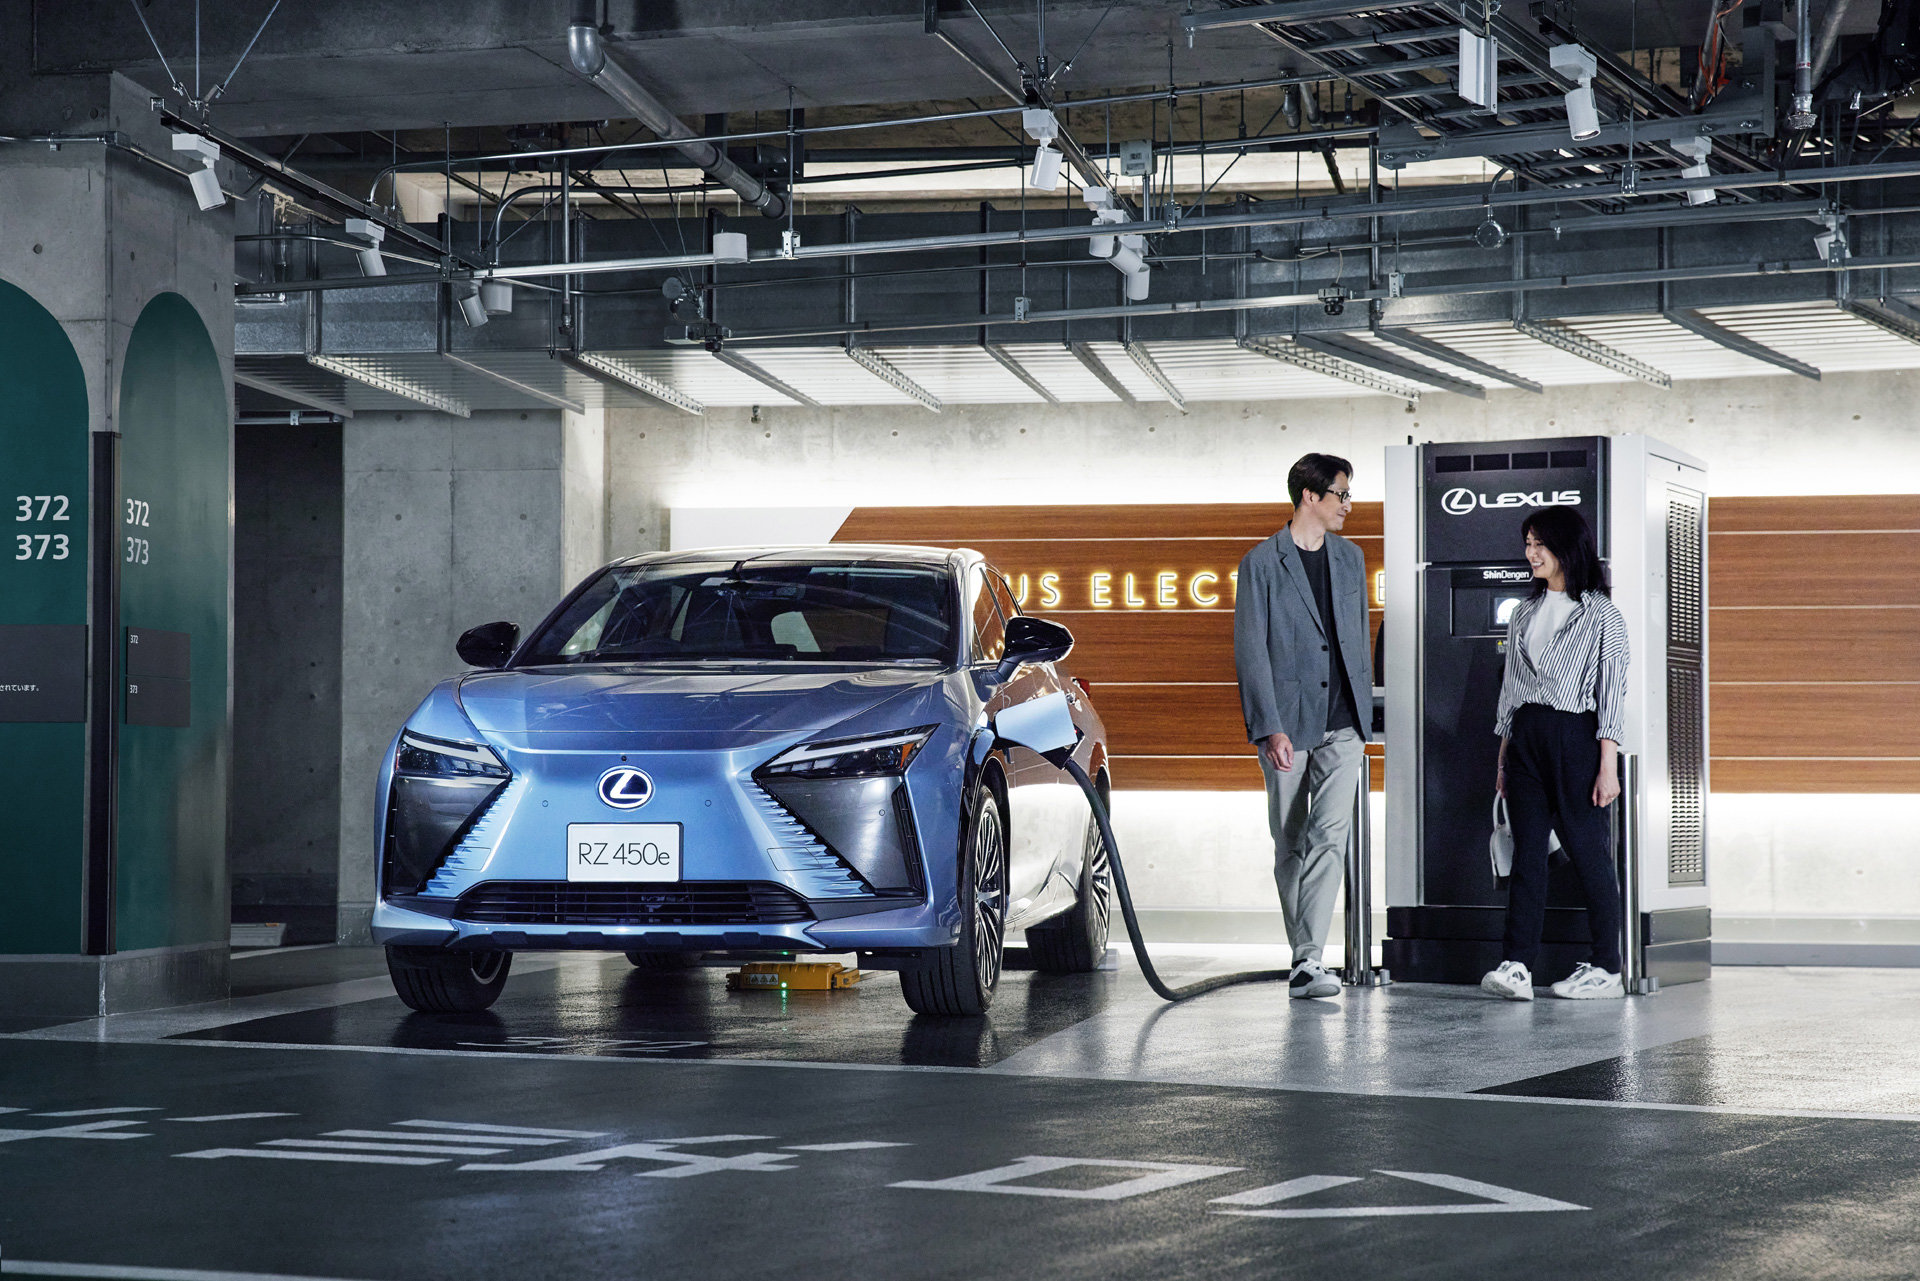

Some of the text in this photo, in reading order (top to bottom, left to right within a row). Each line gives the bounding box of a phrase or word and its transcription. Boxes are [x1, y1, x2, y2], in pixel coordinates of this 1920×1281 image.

[16, 495, 70, 521] 372
[1479, 490, 1581, 509] LEXUS
[126, 498, 150, 527] 372
[16, 533, 70, 560] 373
[126, 536, 149, 565] 373
[1483, 570, 1530, 581] ShinDengen
[130, 634, 139, 644] 372
[129, 684, 138, 694] 373
[578, 842, 670, 866] RZ 450e
[456, 1036, 709, 1053] 372
